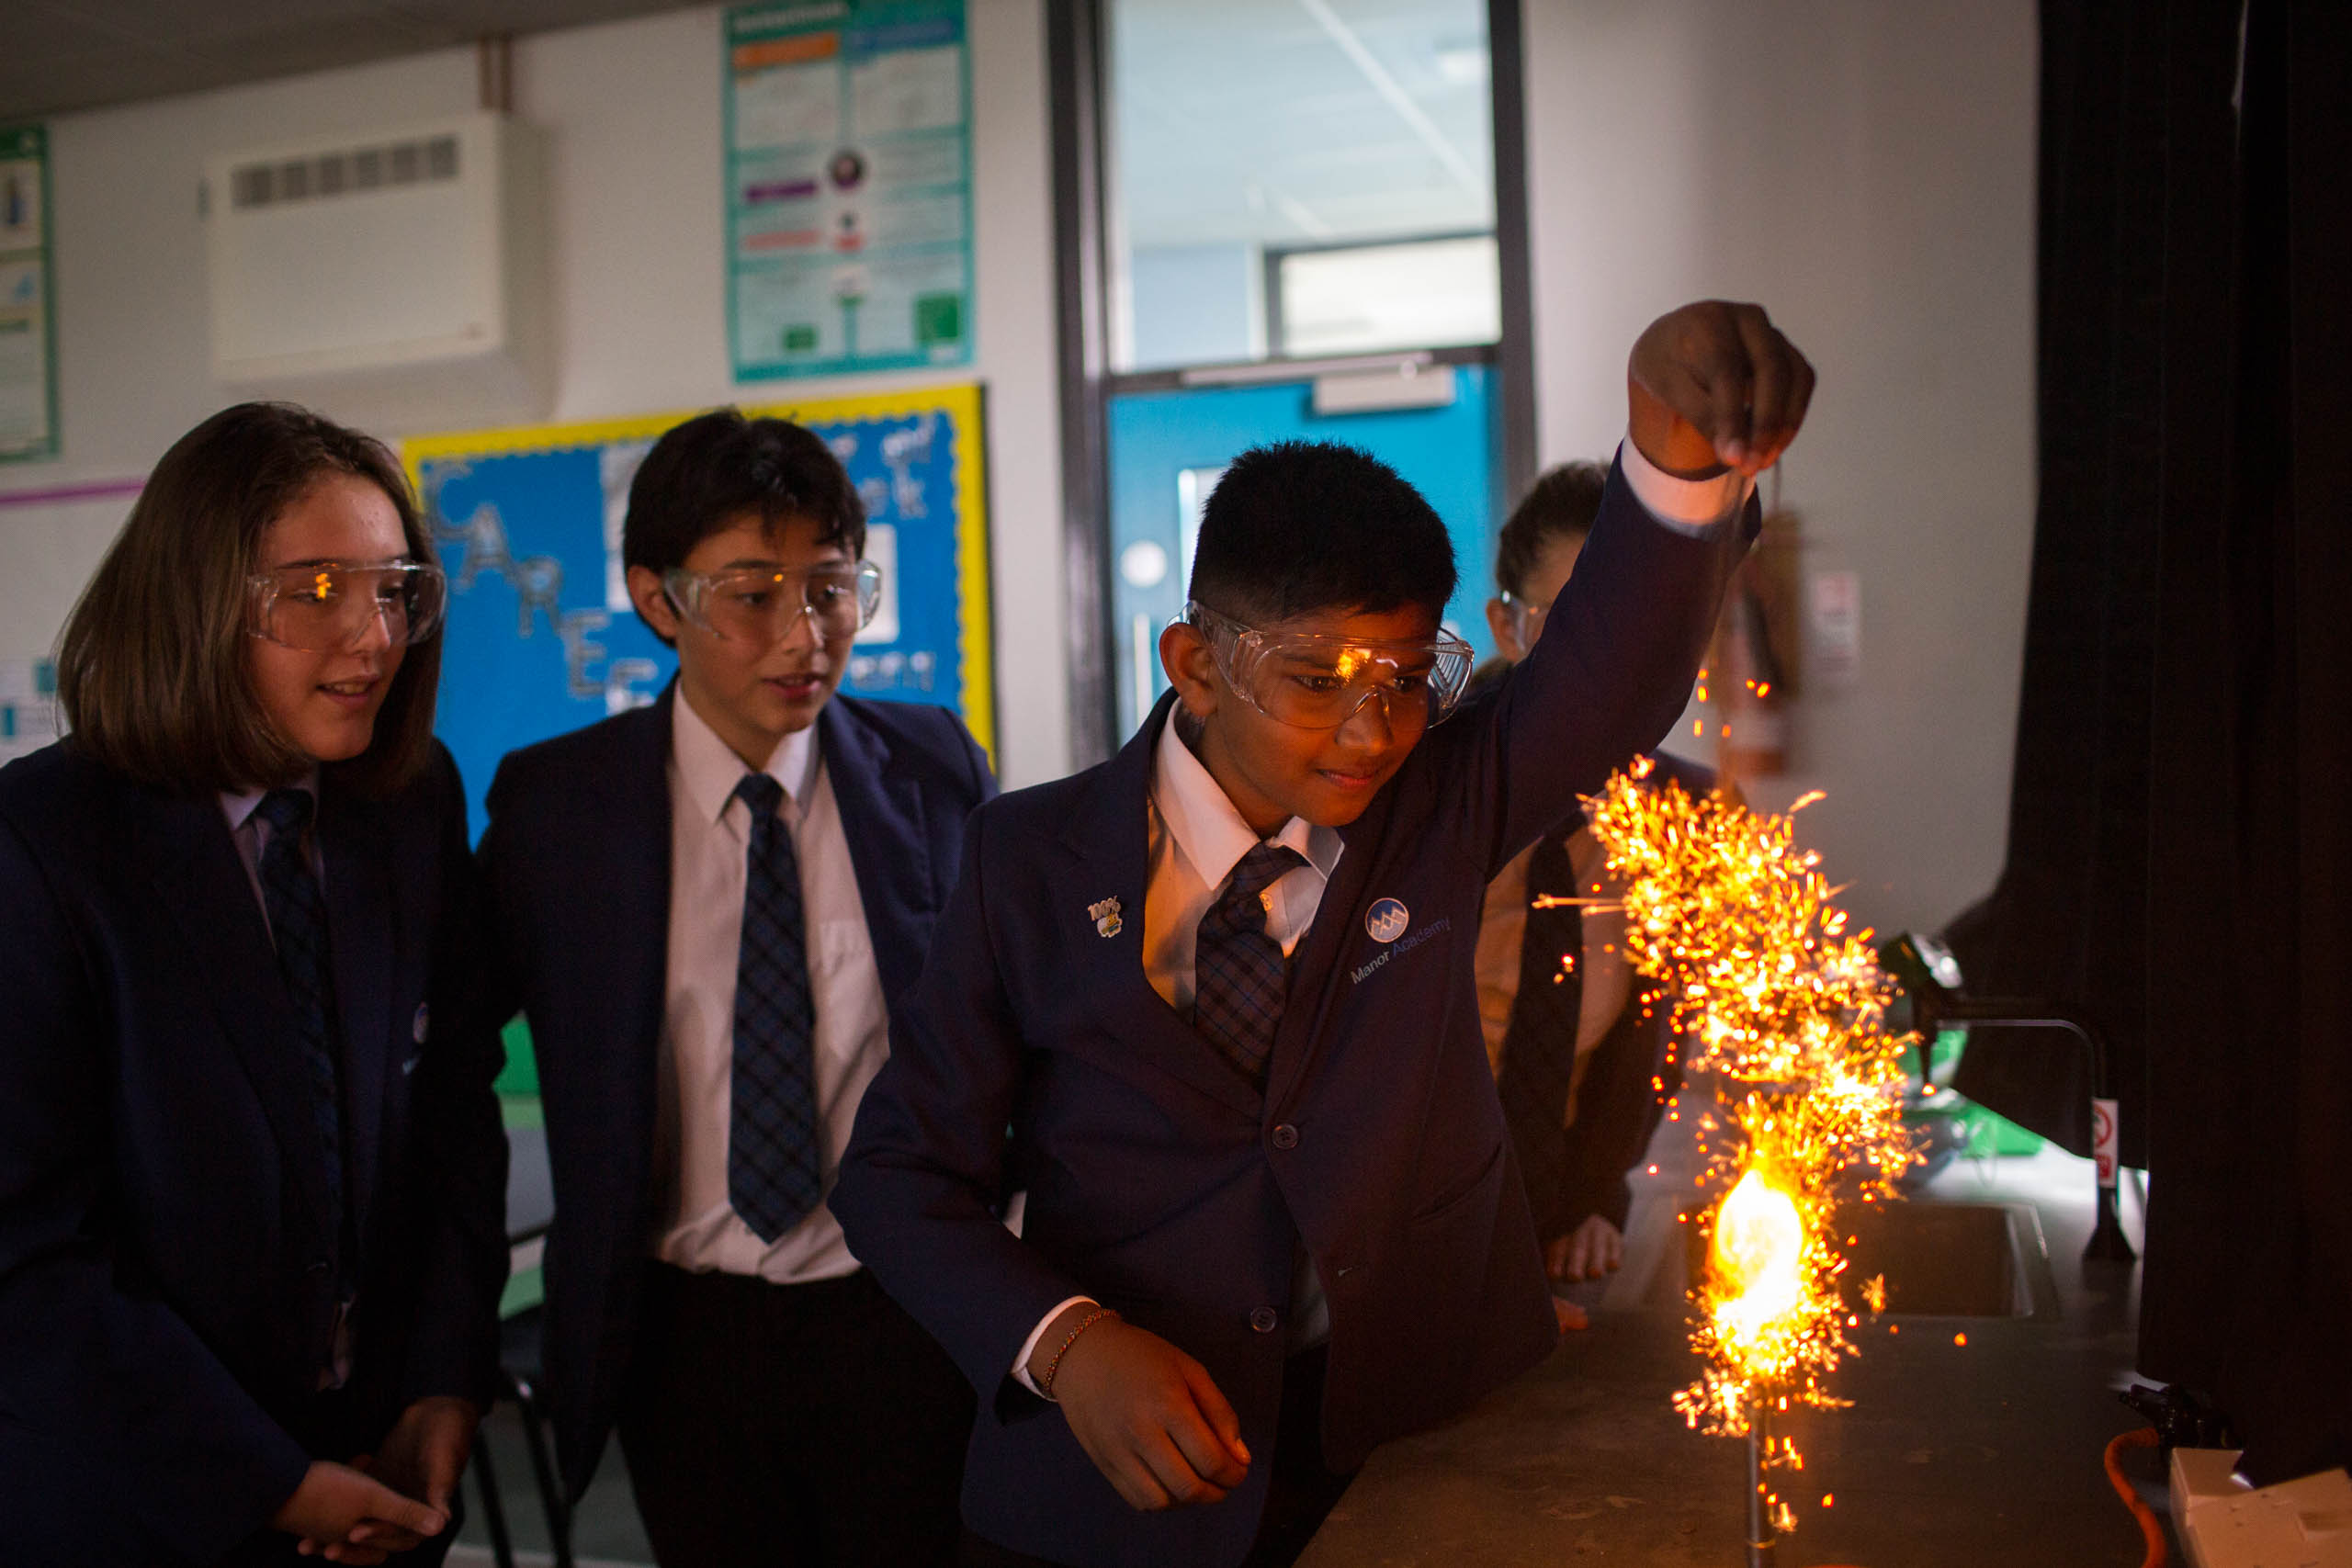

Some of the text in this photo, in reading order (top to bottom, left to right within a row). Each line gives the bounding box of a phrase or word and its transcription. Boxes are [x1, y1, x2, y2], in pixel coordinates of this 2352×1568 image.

[423, 458, 659, 714] CAREE
[1087, 895, 1122, 920] 100%
[1351, 916, 1452, 985] Manor Academy
